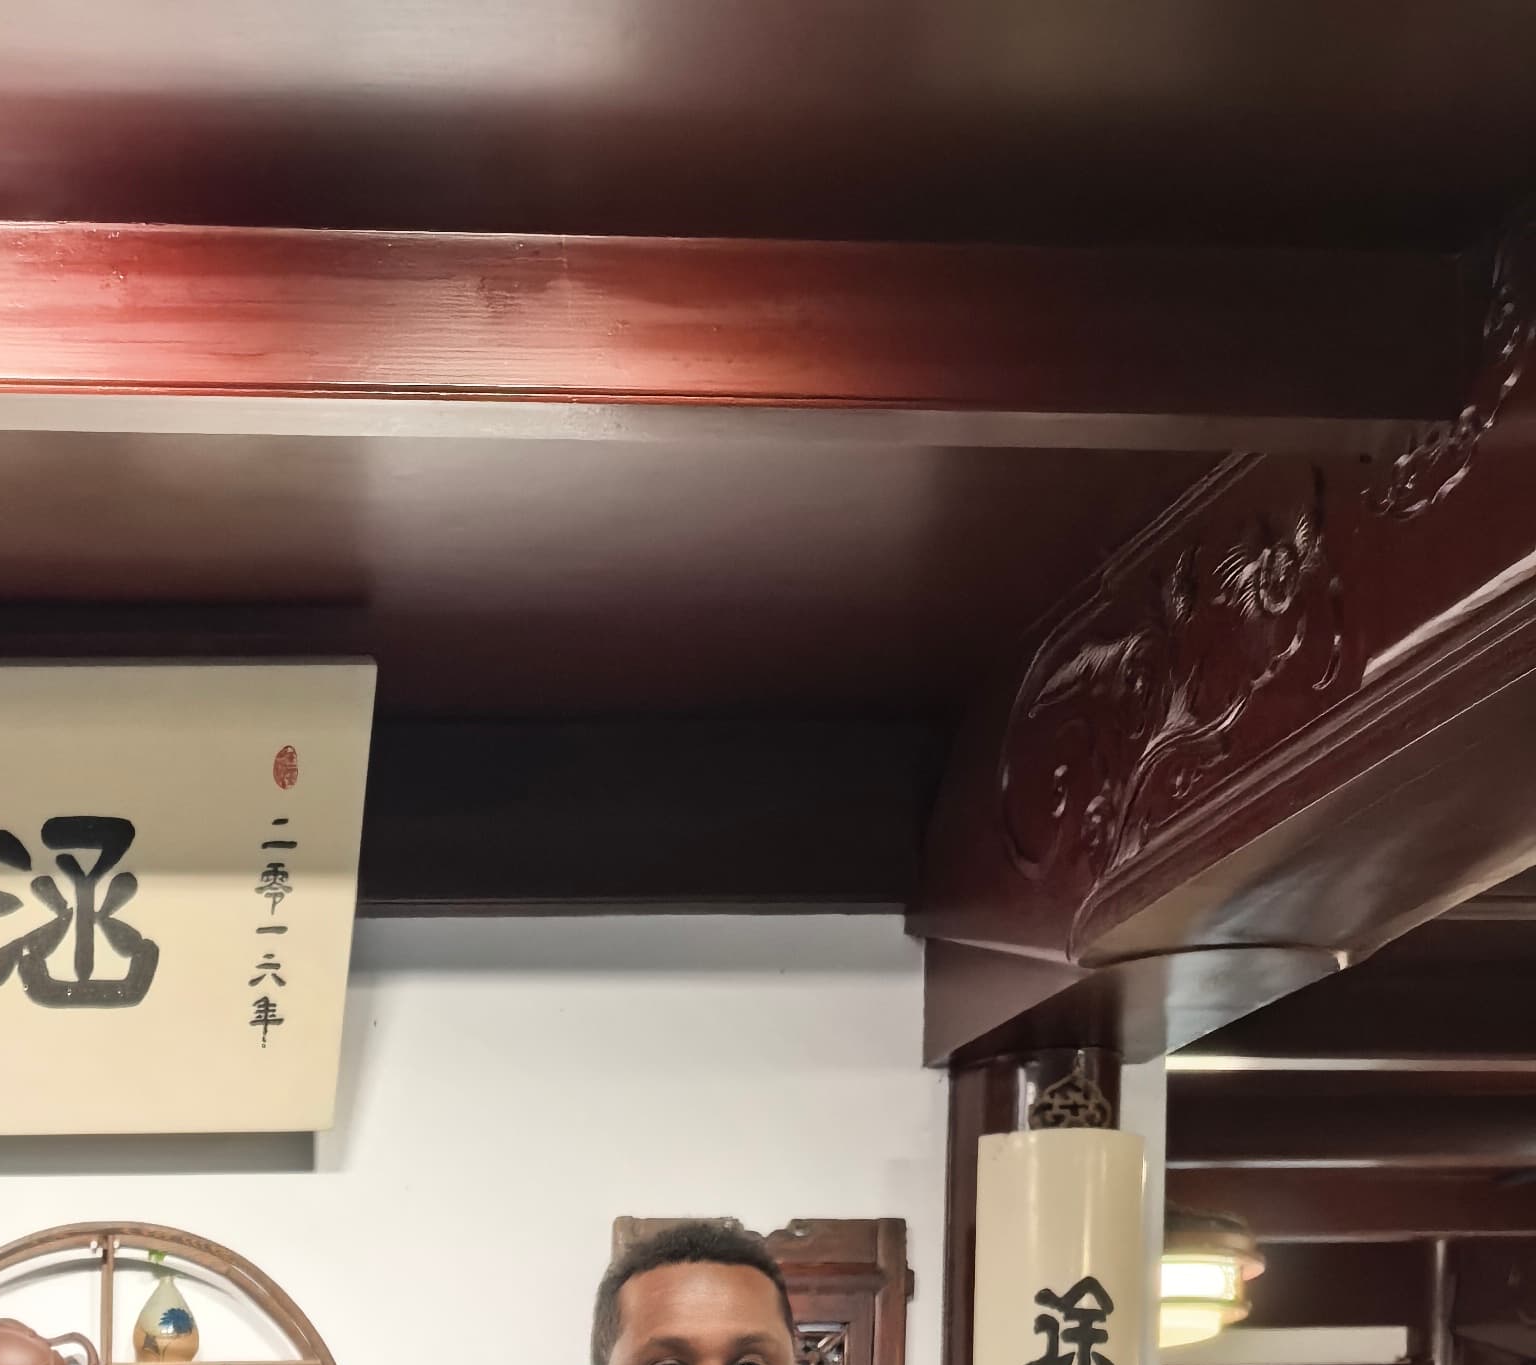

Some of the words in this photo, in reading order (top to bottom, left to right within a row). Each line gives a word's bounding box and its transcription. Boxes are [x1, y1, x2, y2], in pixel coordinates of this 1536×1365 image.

[248, 818, 298, 1049] 二零一六年
